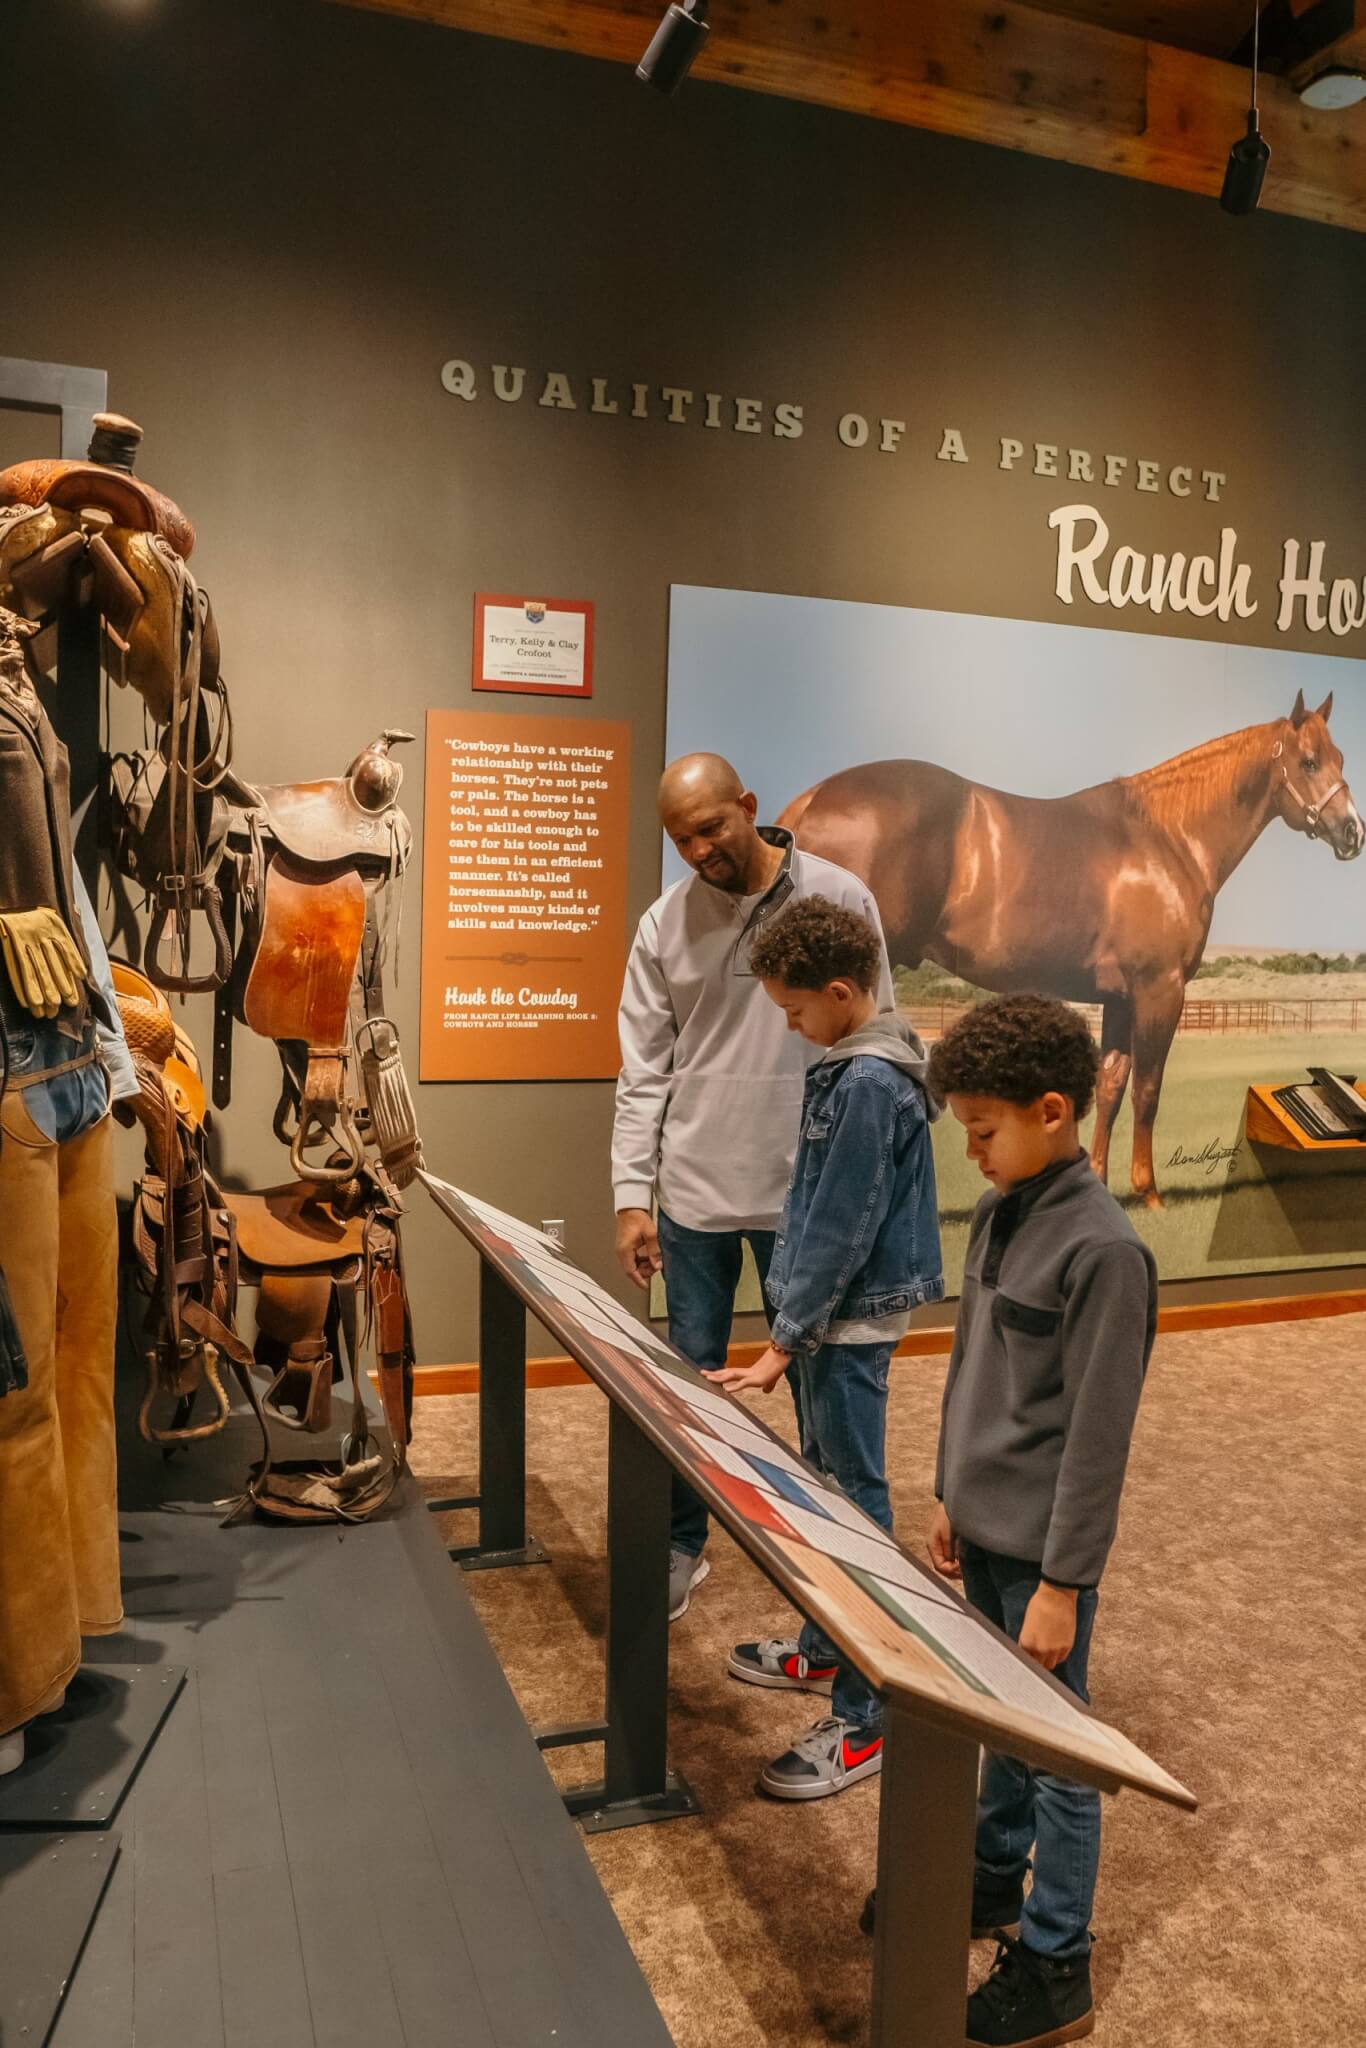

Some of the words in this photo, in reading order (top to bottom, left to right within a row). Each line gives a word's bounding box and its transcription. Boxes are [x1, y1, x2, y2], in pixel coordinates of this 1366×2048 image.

[440, 359, 804, 439] QUALITIES
[838, 412, 906, 453] OF
[937, 428, 968, 462] A
[999, 437, 1226, 501] PERFECT
[1048, 504, 1258, 622] Ranch
[1276, 538, 1366, 636] Ho
[490, 635, 517, 645] Terry,
[521, 637, 544, 647] Kelly
[559, 641, 578, 650] Clay
[517, 648, 551, 658] Crofoot
[514, 743, 544, 754] have
[549, 746, 556, 755] a
[560, 746, 614, 760] working
[451, 757, 533, 771] relationship
[538, 761, 567, 772] with
[571, 762, 603, 773] their
[451, 772, 499, 784] horses.
[557, 779, 577, 788] not
[581, 779, 608, 790] pets
[450, 790, 464, 798] or
[468, 790, 500, 801] pals.
[504, 790, 528, 801] The
[532, 792, 568, 803] horse
[572, 793, 583, 804] is
[587, 796, 595, 804] a
[451, 805, 480, 817] tool,
[484, 806, 508, 817] and
[512, 809, 519, 817] a
[524, 808, 570, 821] cowboy
[574, 809, 597, 820] has
[451, 822, 464, 831] to
[467, 822, 482, 832] be
[486, 822, 532, 834] skilled
[536, 825, 582, 837] enough
[587, 827, 599, 836] to
[449, 840, 477, 848] care
[481, 839, 500, 849] for
[504, 839, 525, 850] his
[528, 840, 559, 851] tools
[563, 842, 587, 851] and
[450, 855, 472, 864] use
[477, 854, 510, 865] them
[514, 855, 527, 865] in
[531, 858, 547, 866] an
[551, 856, 603, 868] efficient
[450, 871, 503, 881] manner.
[532, 872, 570, 883] called
[449, 886, 546, 900] horsemanship,
[550, 888, 573, 899] and
[577, 889, 587, 899] it
[449, 902, 505, 914] involves
[509, 905, 544, 916] many
[548, 904, 584, 915] kinds
[588, 905, 600, 915] of
[448, 919, 486, 929] skills
[490, 919, 514, 929] and
[445, 987, 488, 1006] Hank
[491, 987, 515, 1005] the
[518, 988, 577, 1009] Cowdog
